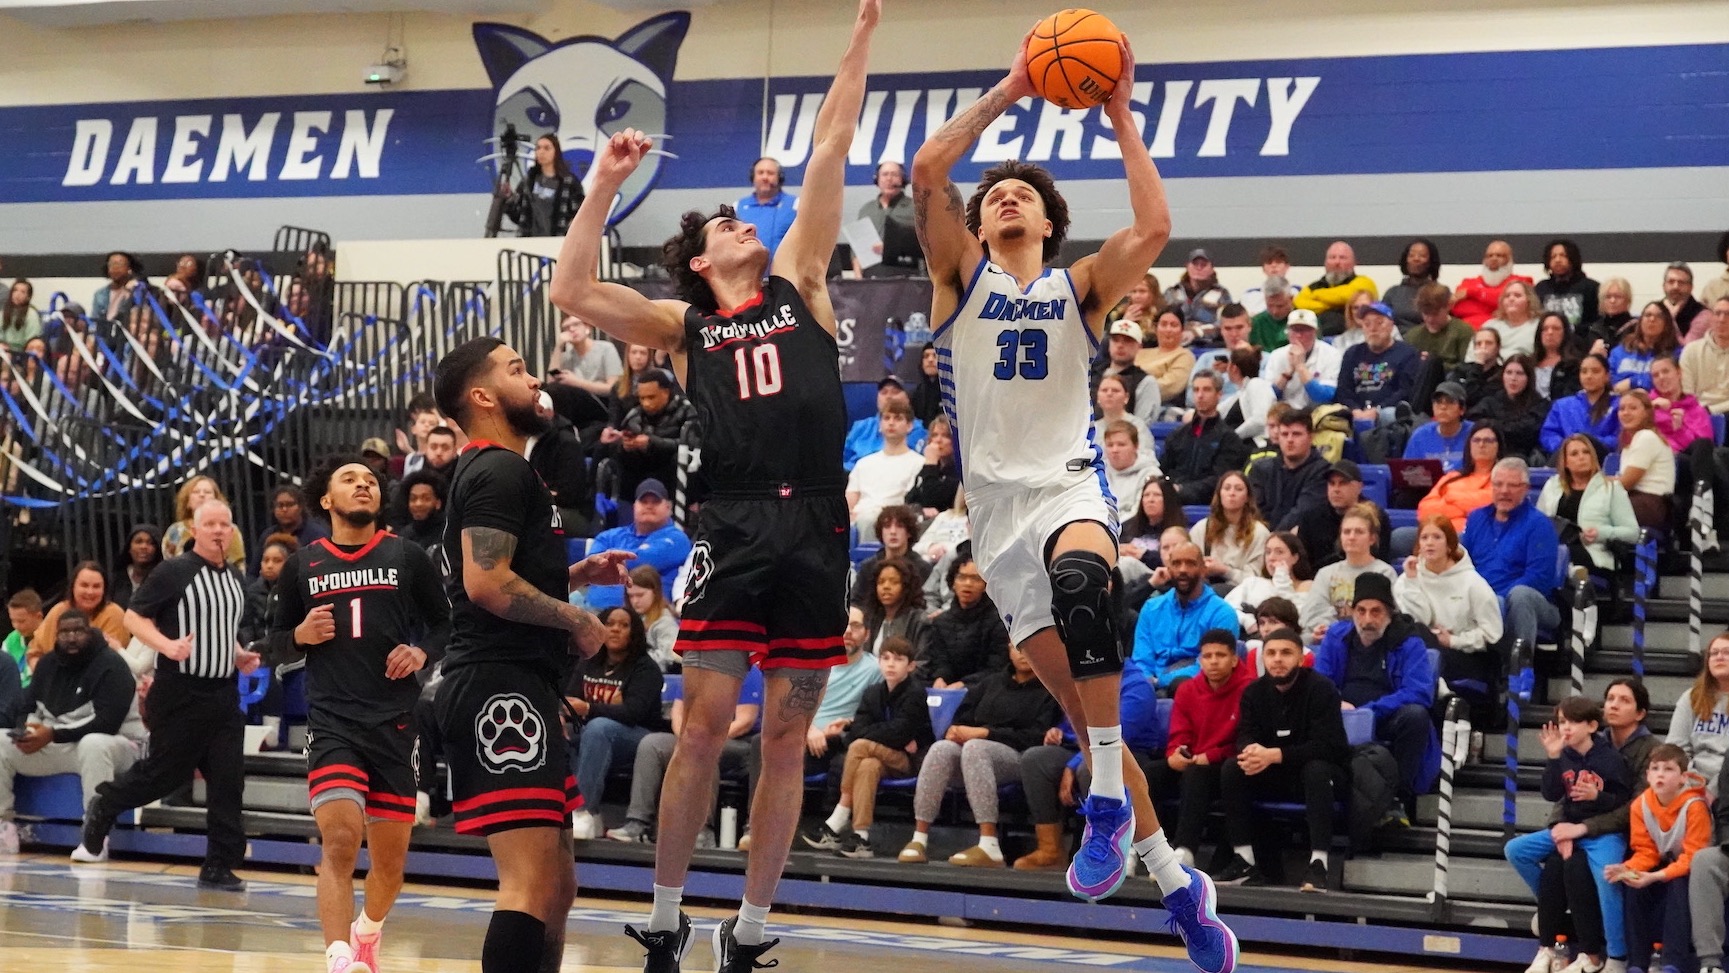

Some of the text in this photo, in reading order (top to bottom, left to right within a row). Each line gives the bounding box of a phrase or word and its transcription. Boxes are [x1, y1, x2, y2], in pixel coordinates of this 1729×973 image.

[61, 108, 395, 187] DAEMEN
[734, 343, 783, 400] 10
[993, 328, 1049, 380] 33
[350, 597, 362, 638] 1
